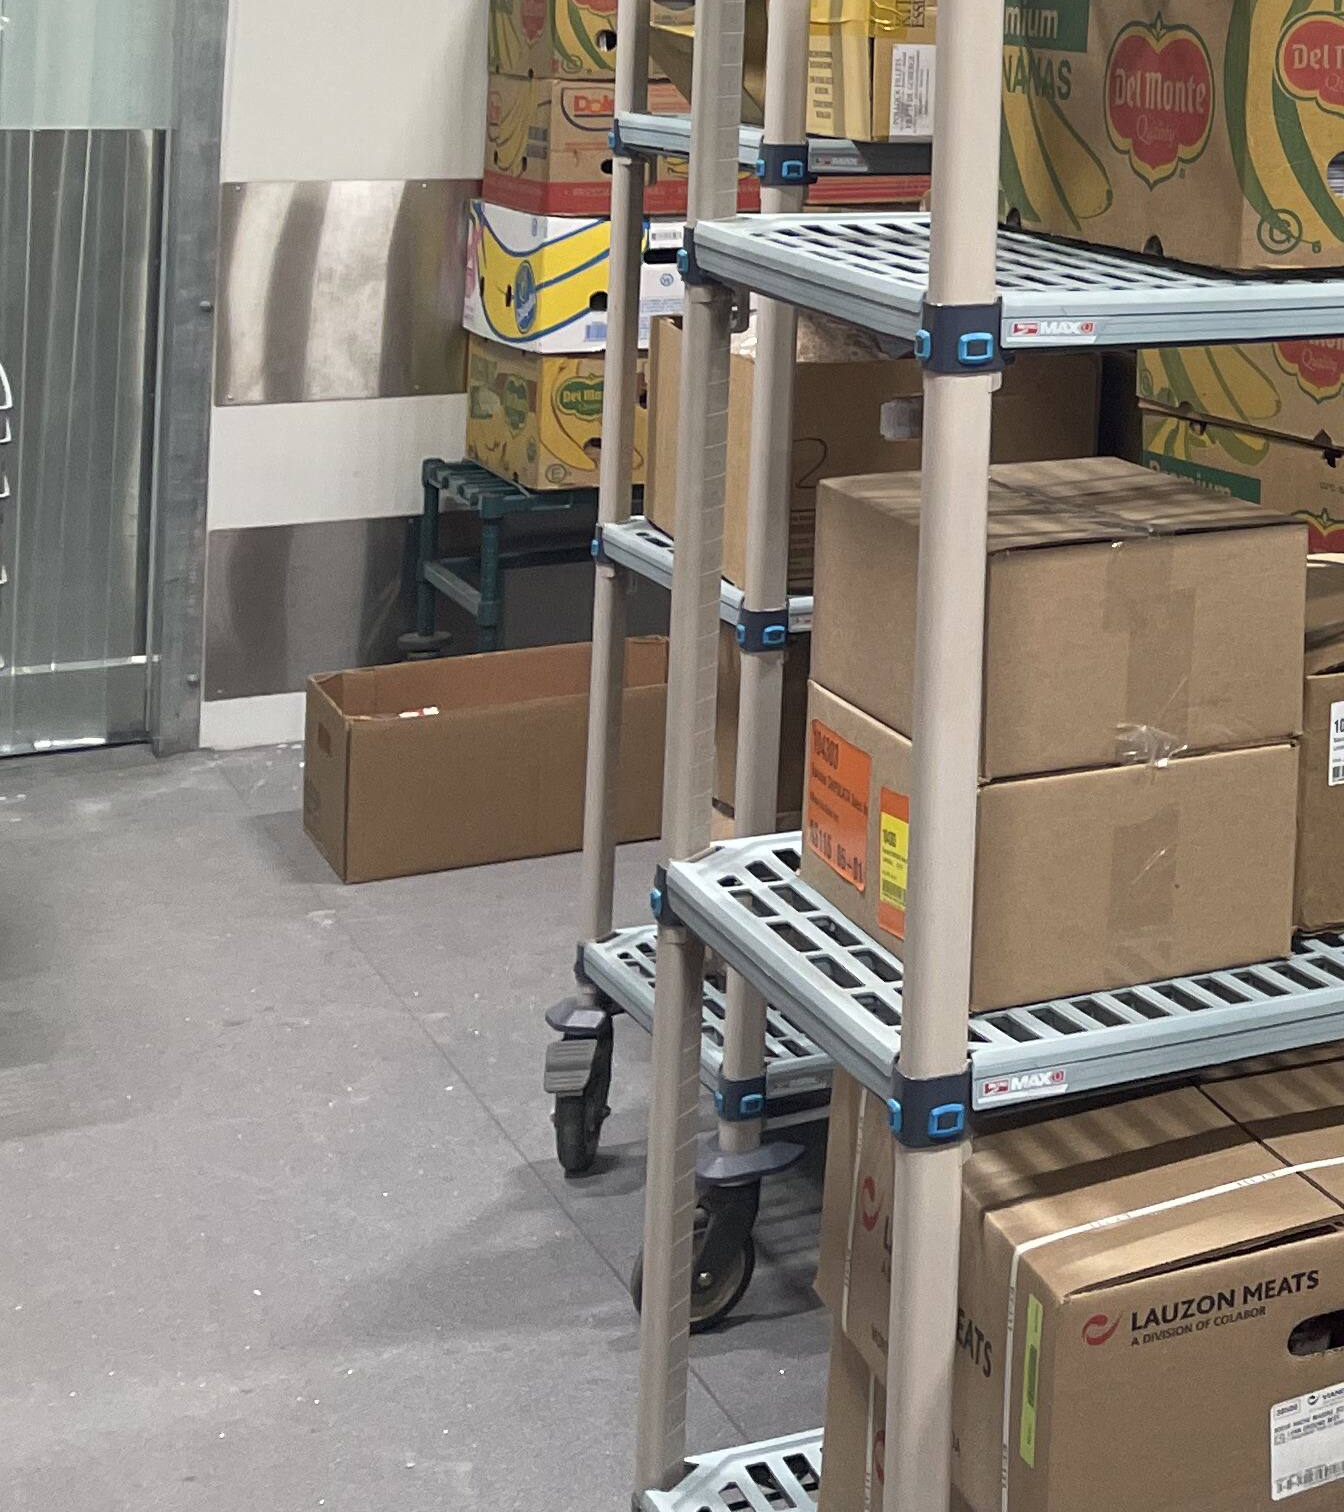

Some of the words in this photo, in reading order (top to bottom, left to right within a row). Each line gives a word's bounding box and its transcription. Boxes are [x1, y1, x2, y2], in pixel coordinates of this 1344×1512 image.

[1292, 43, 1329, 69] Del
[1114, 68, 1141, 107] Del
[1145, 72, 1207, 116] Monte
[1130, 1288, 1236, 1333] LAUZON
[1241, 1269, 1321, 1308] MEATS
[1130, 1336, 1140, 1348] A
[1142, 1320, 1193, 1346] DIVISION
[1195, 1317, 1212, 1333] OF
[1213, 1305, 1267, 1330] COLABOR
